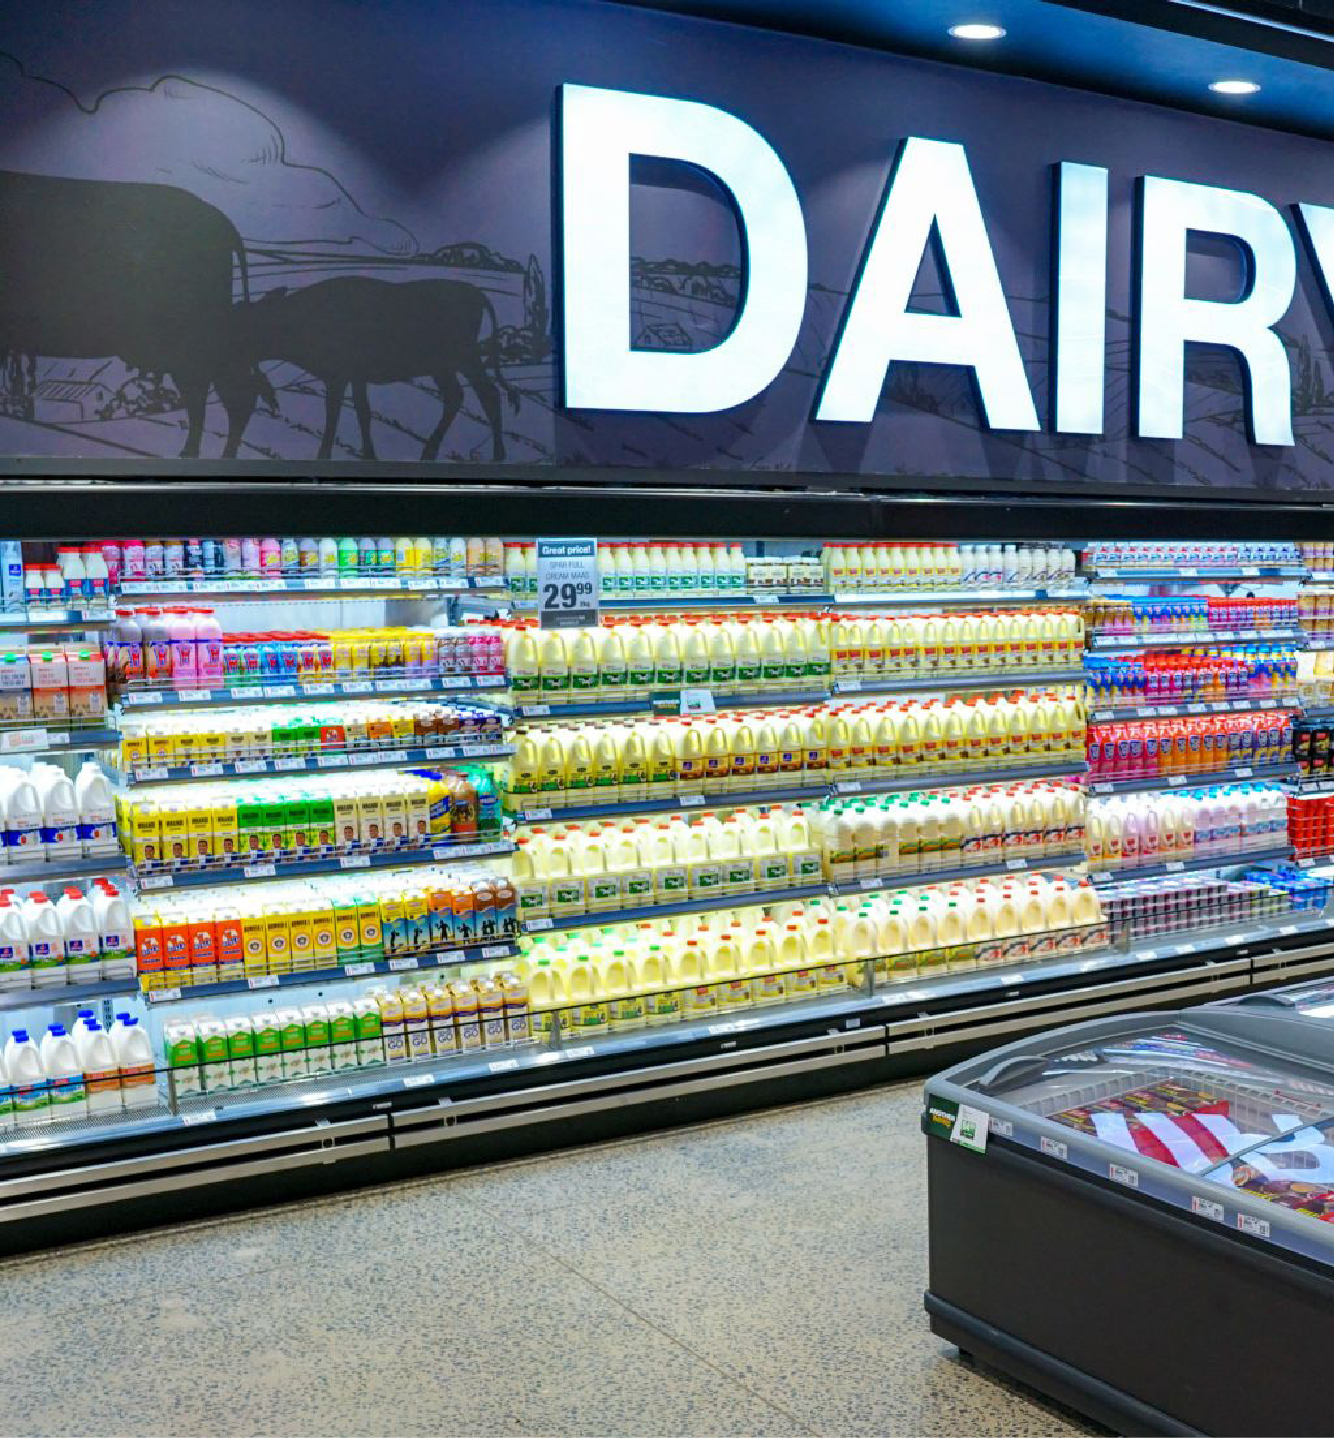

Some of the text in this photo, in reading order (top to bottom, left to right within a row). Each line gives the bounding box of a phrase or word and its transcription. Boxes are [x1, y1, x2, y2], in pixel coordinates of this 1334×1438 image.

[542, 545, 591, 555] Great price!
[569, 561, 585, 569] FULL
[546, 572, 569, 580] CREAM
